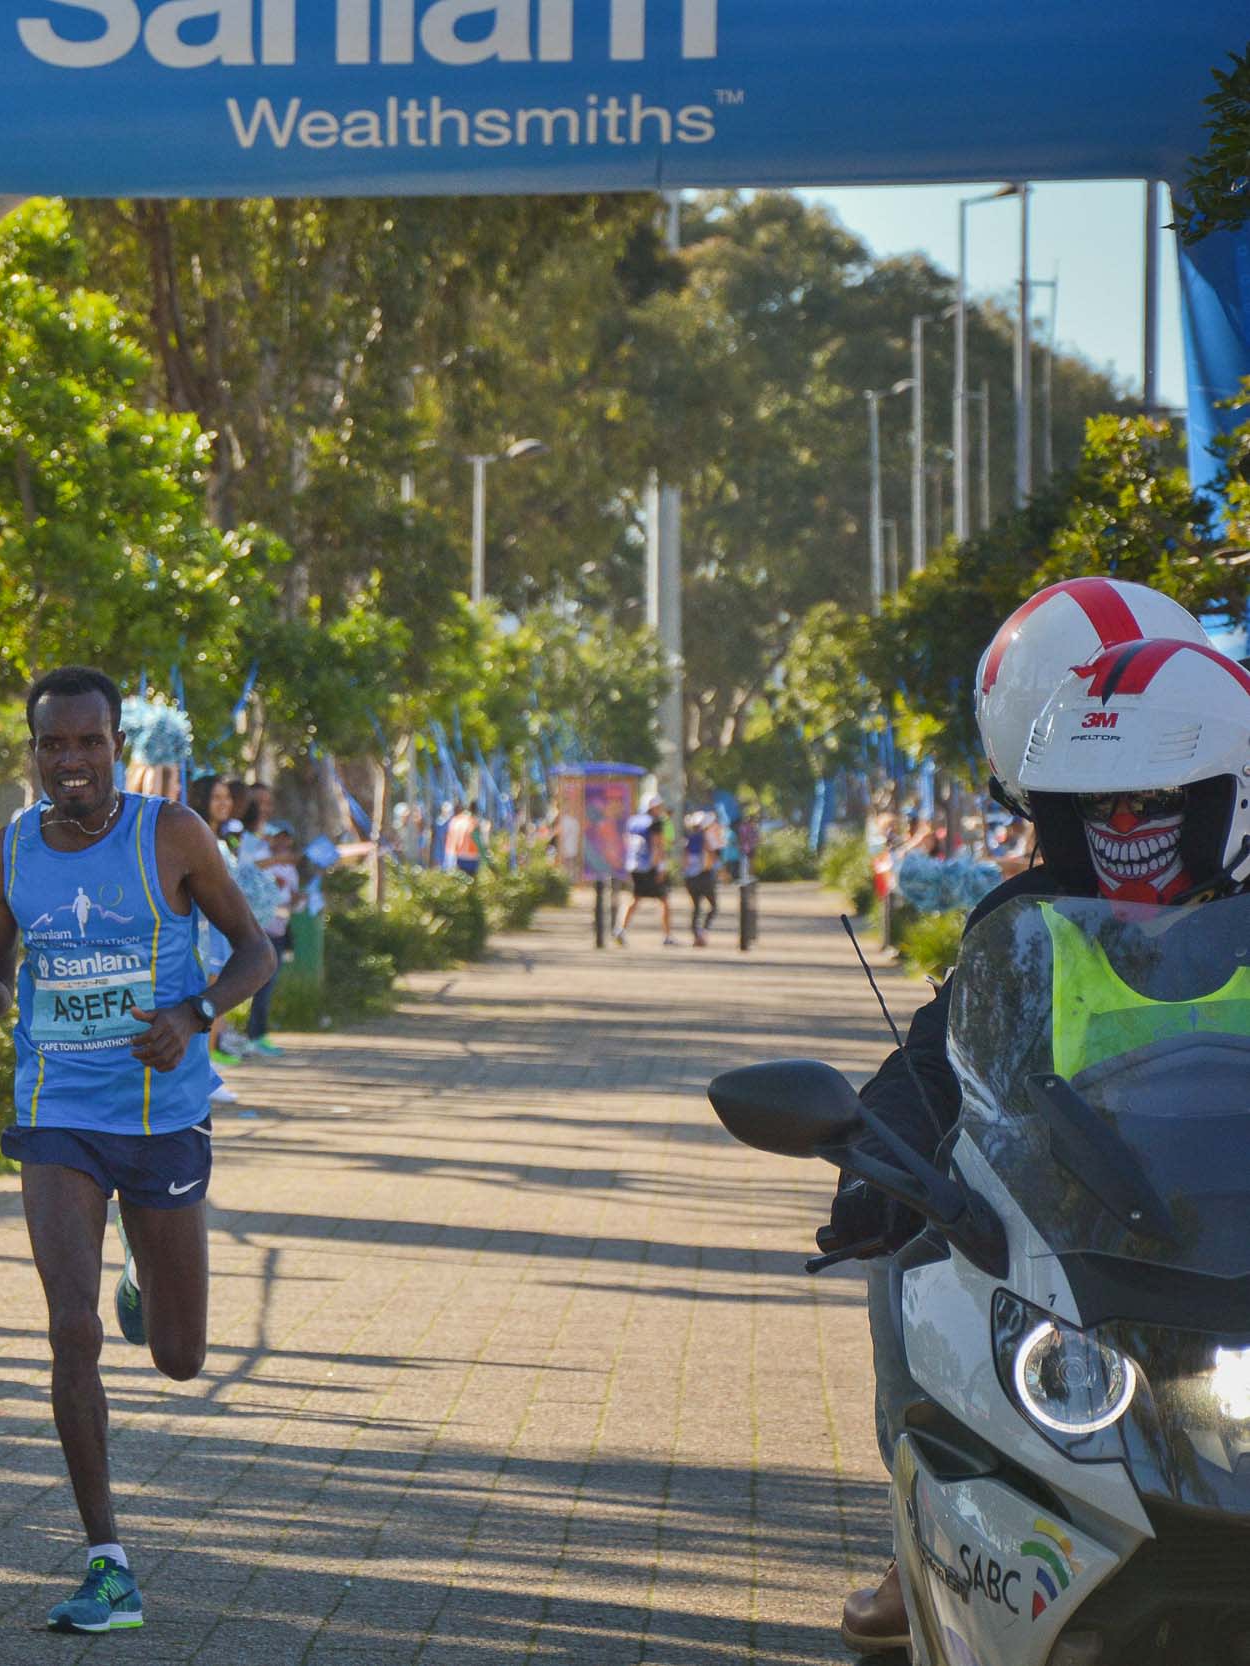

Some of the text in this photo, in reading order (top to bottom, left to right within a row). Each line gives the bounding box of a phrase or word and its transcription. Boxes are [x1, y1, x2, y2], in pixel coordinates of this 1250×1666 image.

[1081, 712, 1119, 728] 3M
[1070, 734, 1122, 742] PELTOR
[53, 952, 141, 977] Sanlam
[53, 989, 137, 1022] ASEFA
[81, 1025, 97, 1036] 47
[38, 1041, 59, 1051] CAPE
[59, 1040, 83, 1051] TOWN
[959, 1543, 1022, 1616] SABC
